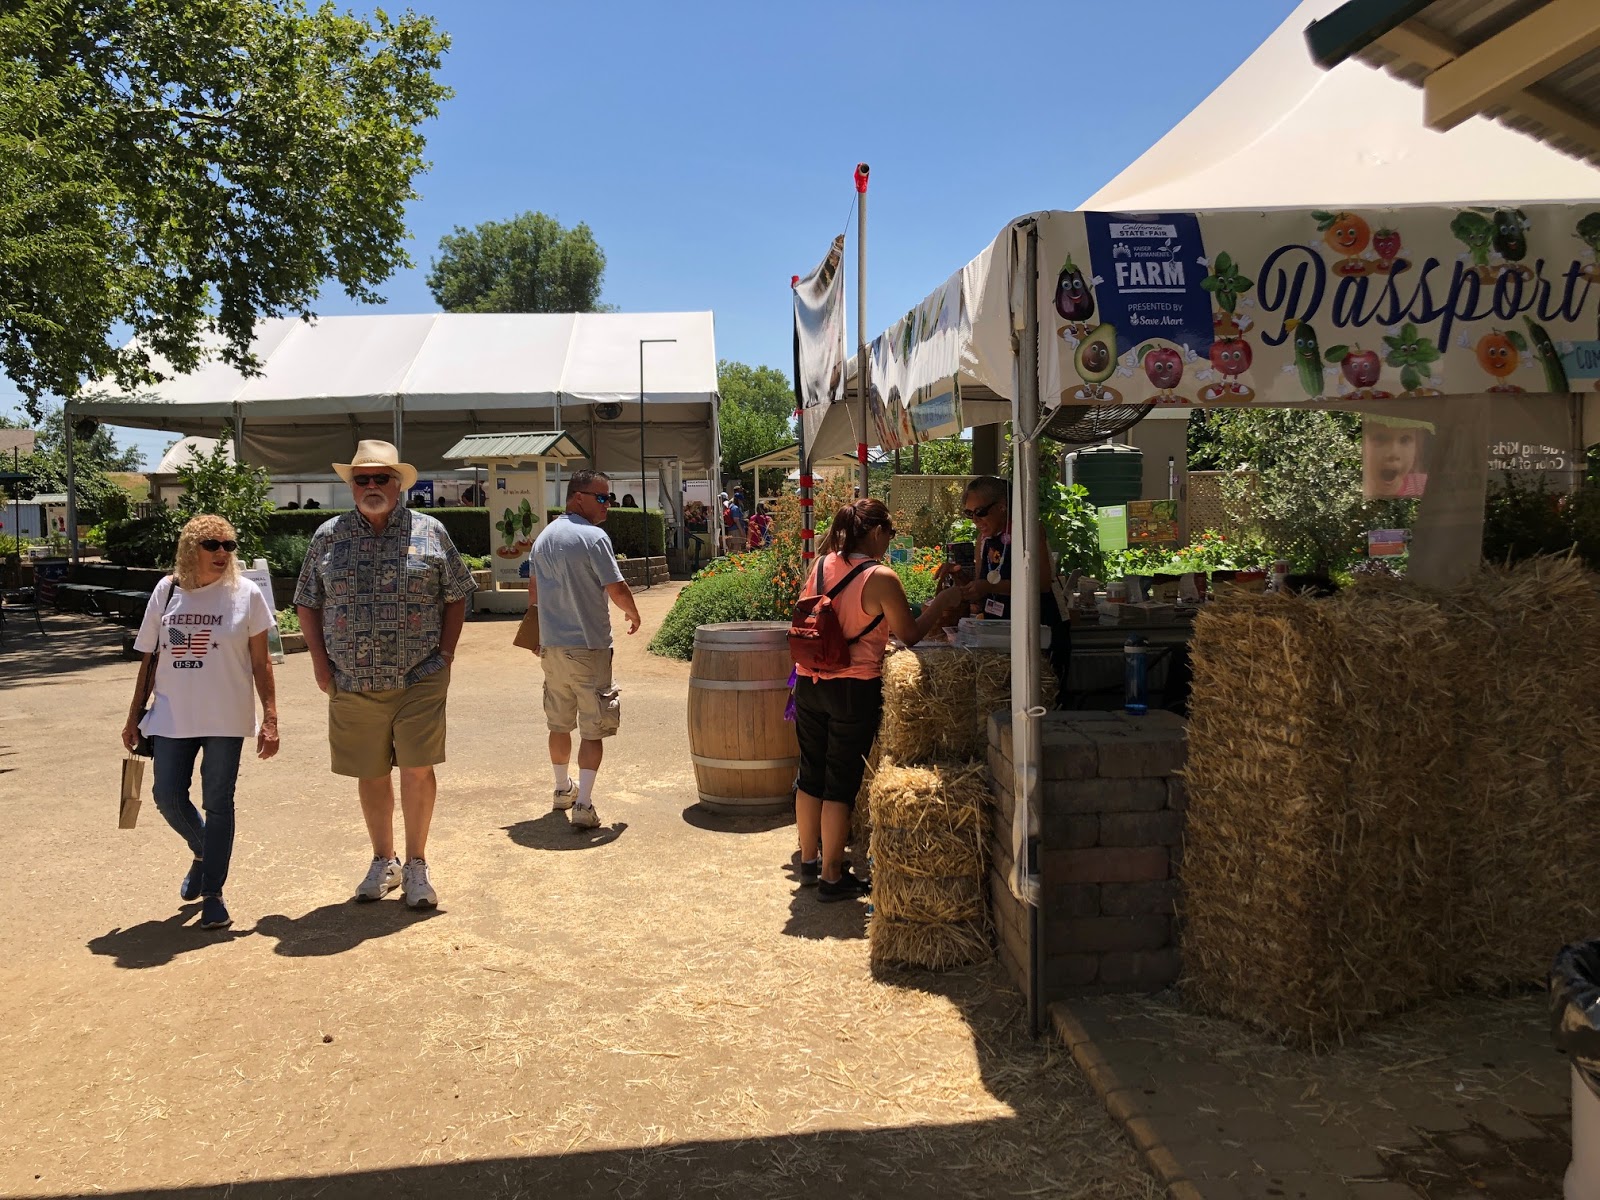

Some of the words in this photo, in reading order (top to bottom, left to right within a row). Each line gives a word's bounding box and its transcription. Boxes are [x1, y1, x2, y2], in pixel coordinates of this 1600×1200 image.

[1115, 262, 1185, 286] FARM
[1257, 244, 1592, 354] Passport
[1127, 302, 1172, 312] PRESENTED
[1172, 303, 1183, 312] BY
[1139, 315, 1160, 326] Save
[1160, 315, 1184, 326] Mart
[162, 614, 224, 626] FREEDOM
